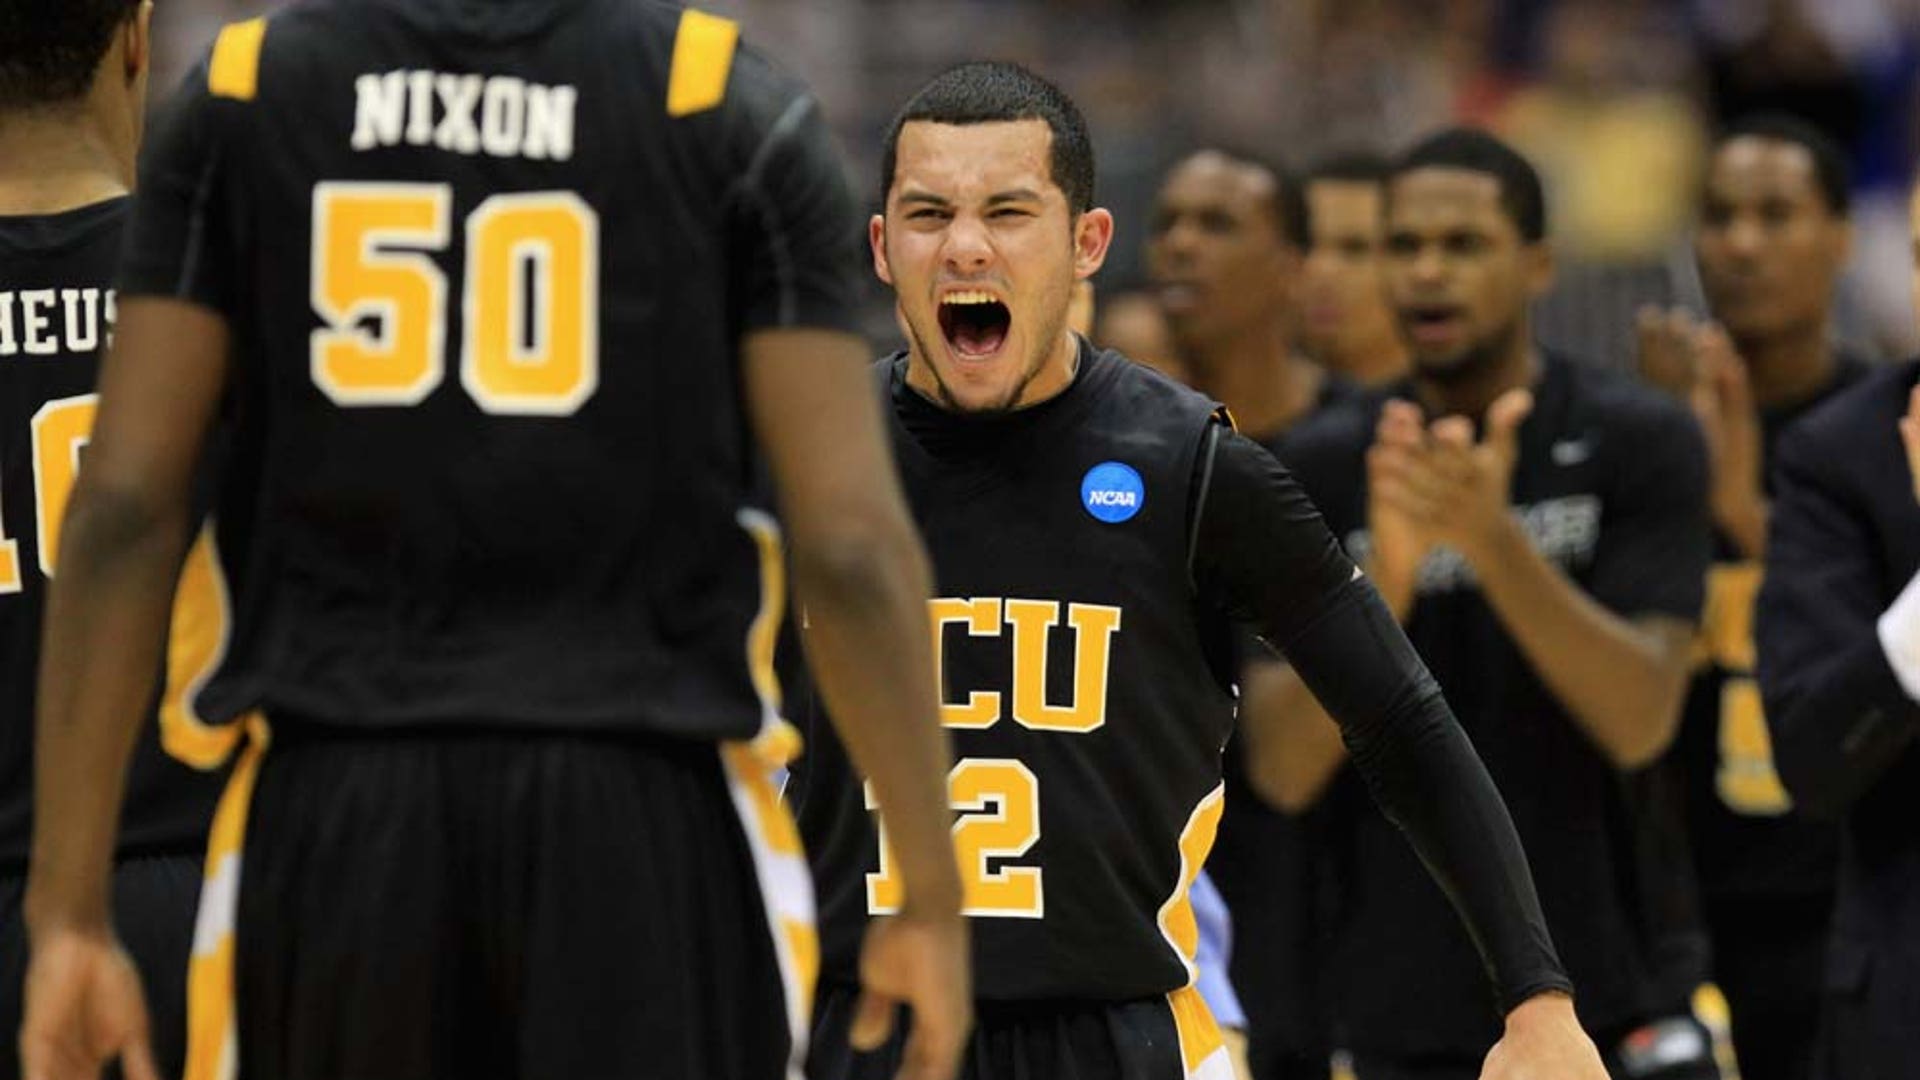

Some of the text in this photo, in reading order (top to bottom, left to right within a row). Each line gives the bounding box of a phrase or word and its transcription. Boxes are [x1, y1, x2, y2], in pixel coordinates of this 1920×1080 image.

[351, 70, 578, 161] NIXON
[310, 181, 599, 416] 50
[1089, 490, 1136, 507] NCAA
[926, 597, 1121, 733] CU
